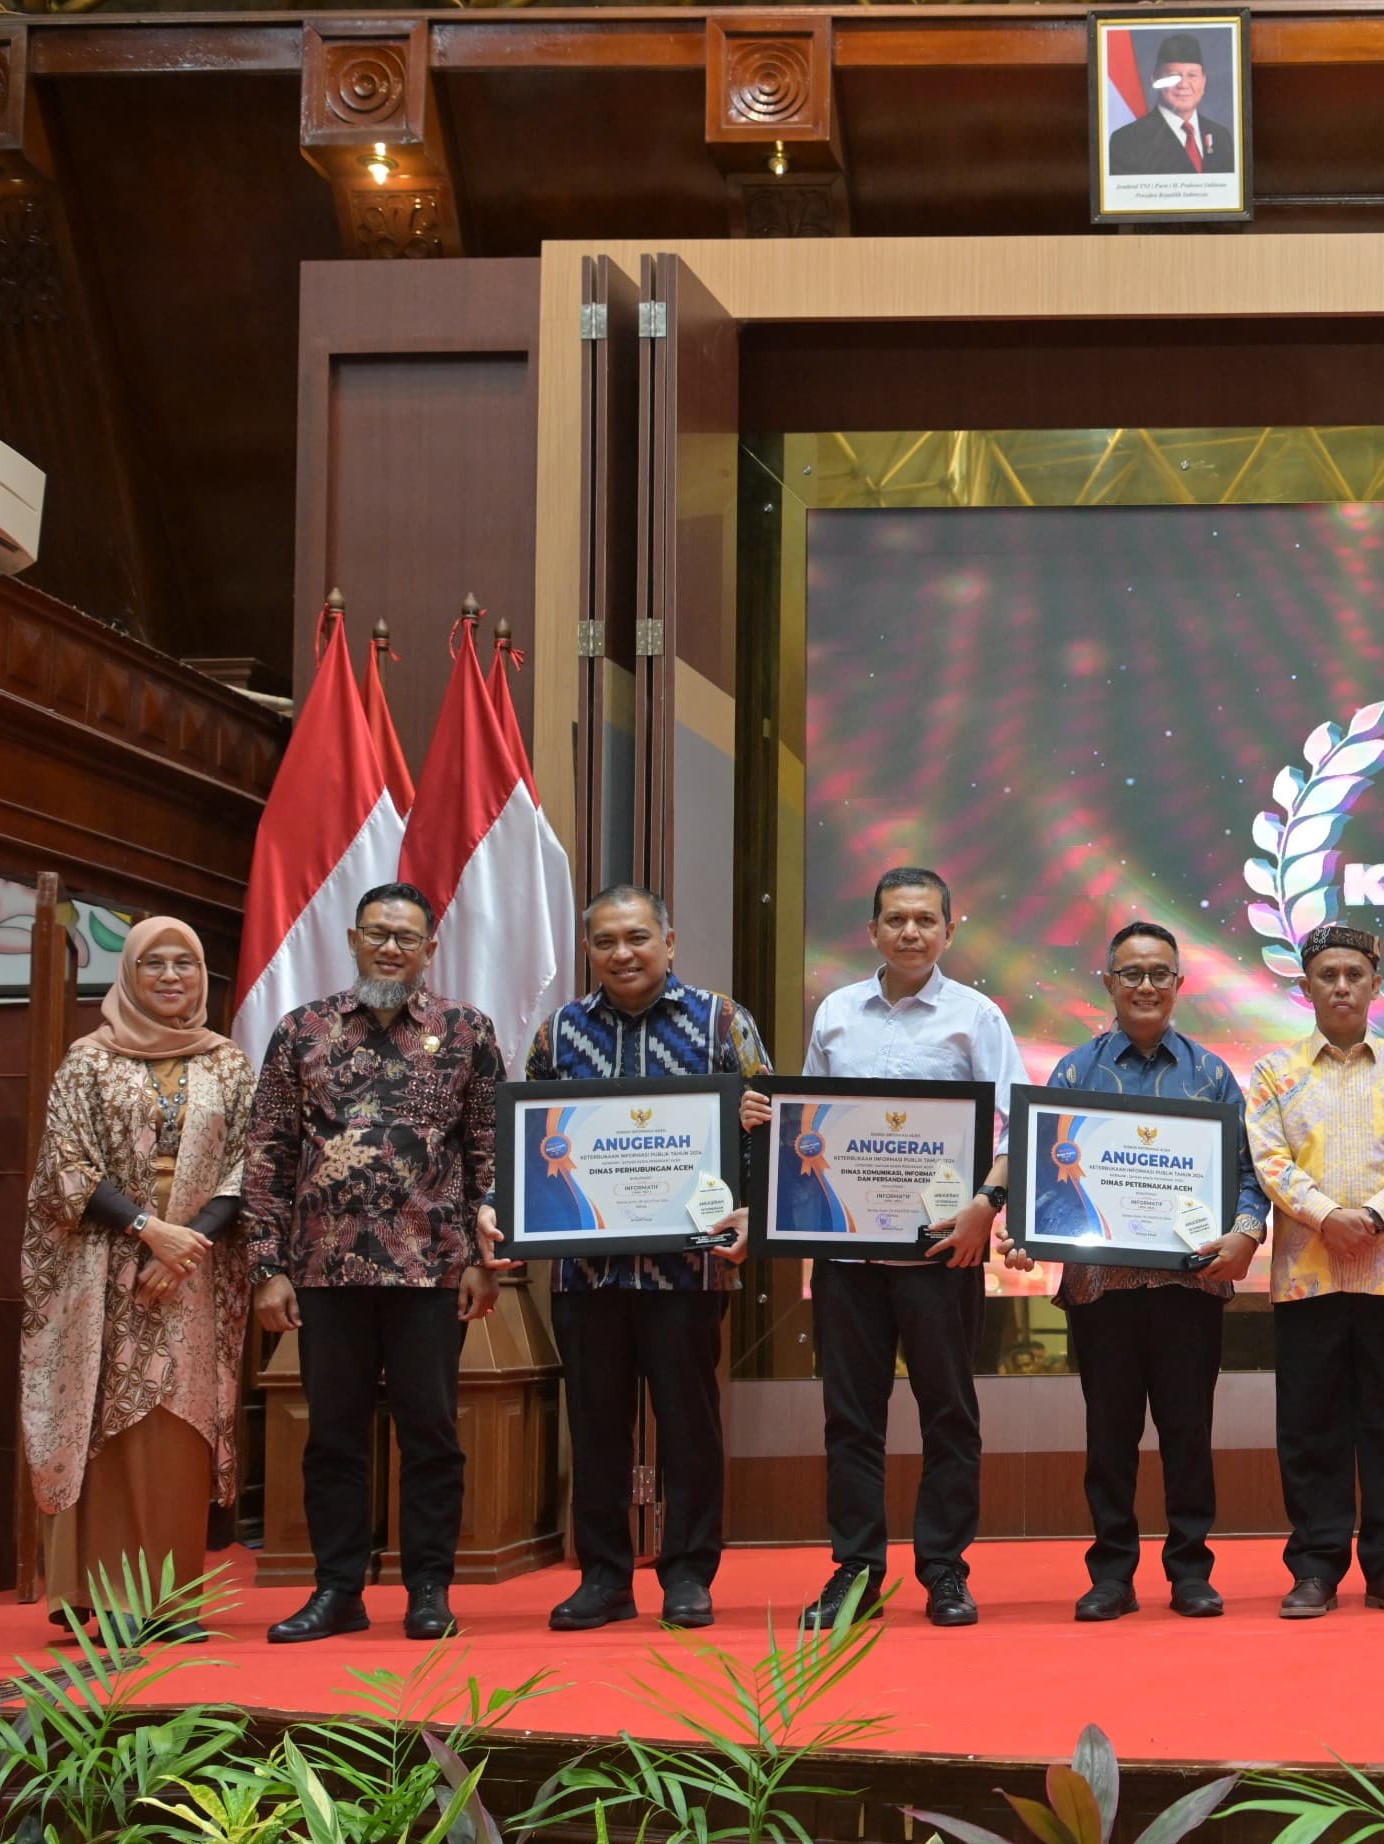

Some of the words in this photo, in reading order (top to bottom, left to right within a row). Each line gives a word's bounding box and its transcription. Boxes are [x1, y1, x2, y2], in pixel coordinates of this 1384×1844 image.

[593, 1135, 691, 1151] ANUGERAH
[846, 1139, 945, 1155] ANUGERAH
[1101, 1150, 1194, 1170] ANUGERAH
[615, 1165, 672, 1174] PERHUBUNGAN
[1100, 1179, 1124, 1187] DINAS
[1125, 1181, 1172, 1191] PETERNAKAN
